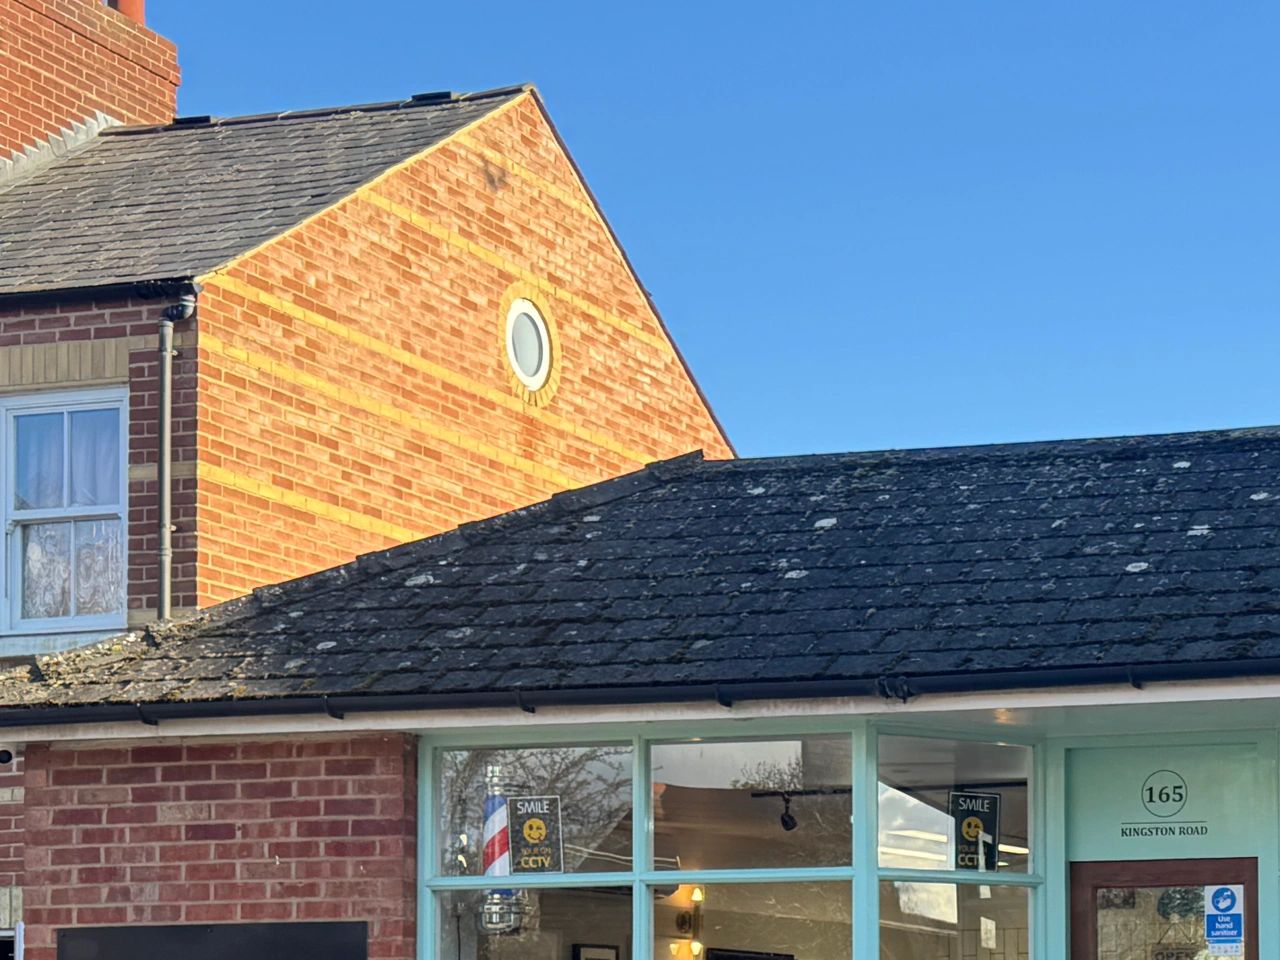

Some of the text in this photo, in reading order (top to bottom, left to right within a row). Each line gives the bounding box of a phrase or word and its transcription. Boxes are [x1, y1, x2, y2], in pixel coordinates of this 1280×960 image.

[1144, 785, 1184, 804] 165
[517, 801, 549, 814] SMILE
[959, 798, 989, 812] SMILE
[1121, 826, 1208, 837] KINGSTON ROAD
[520, 856, 551, 868] CCTV
[1217, 915, 1231, 923] Use
